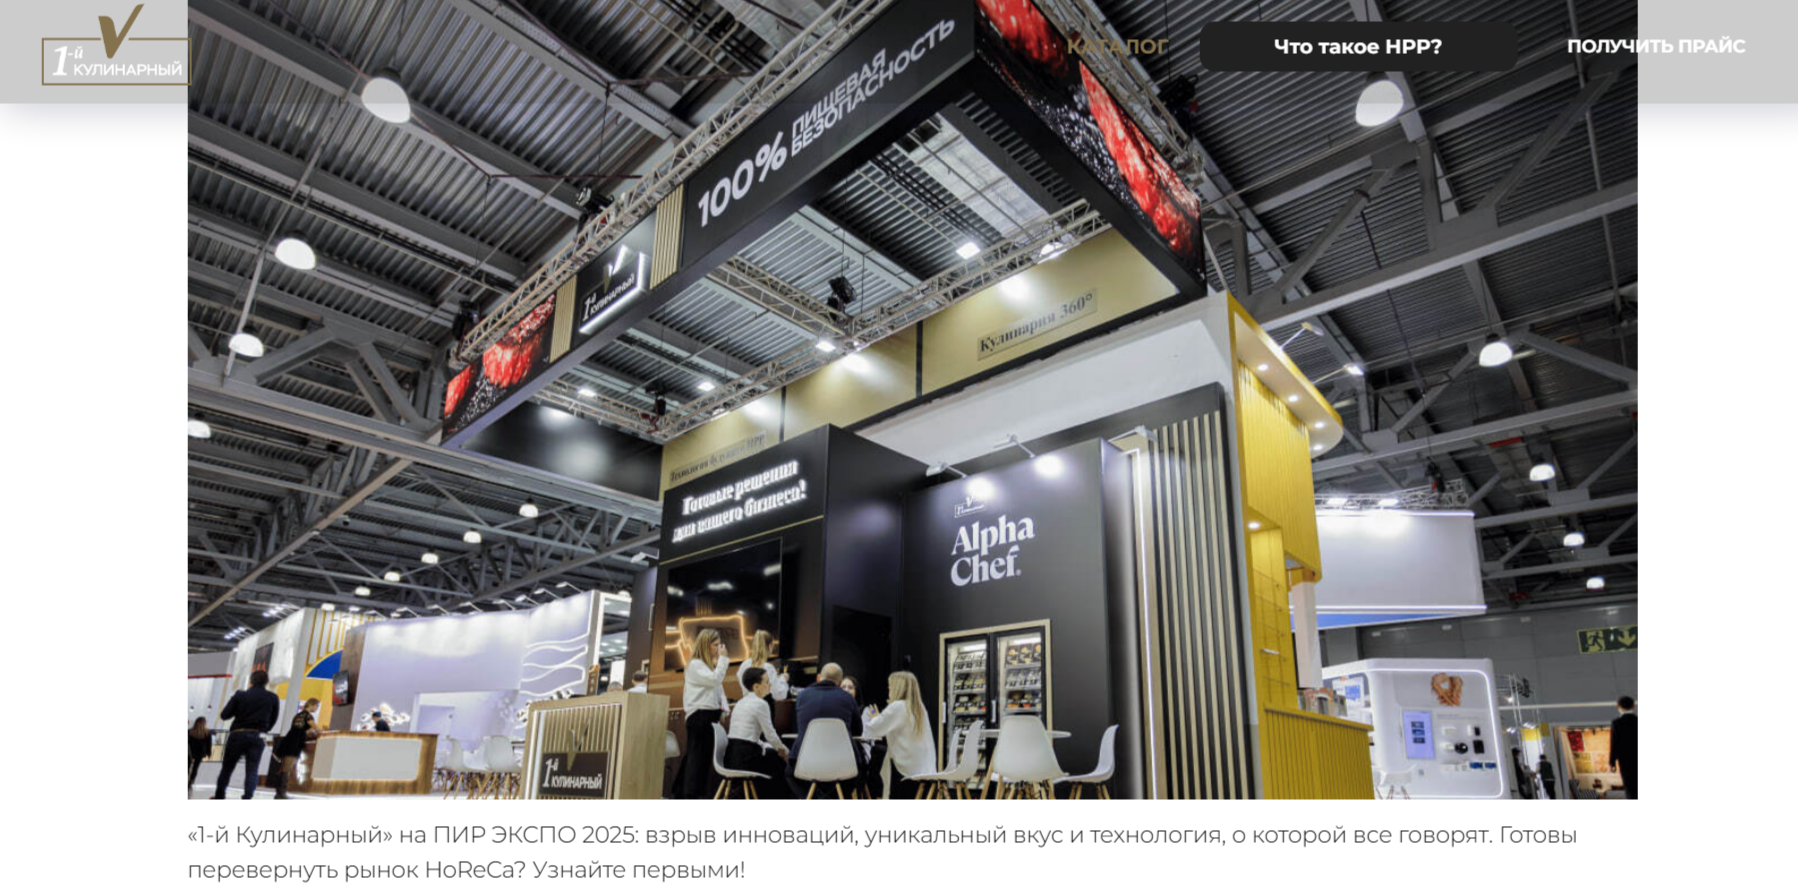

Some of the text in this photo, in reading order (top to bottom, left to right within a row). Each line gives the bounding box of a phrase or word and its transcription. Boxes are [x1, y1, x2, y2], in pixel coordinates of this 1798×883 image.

[790, 19, 955, 157] БЕЗОПАСНОСТЬ
[698, 48, 886, 228] 100% ПИЩЕВАЯ
[980, 292, 1093, 352] Кулинария 360°
[682, 459, 800, 516] Готовые решения
[697, 505, 744, 534] вашего
[743, 478, 808, 517] бизнеса!
[950, 514, 1036, 557] Alpha
[550, 773, 603, 790] КУЛИНАРНЫЙ
